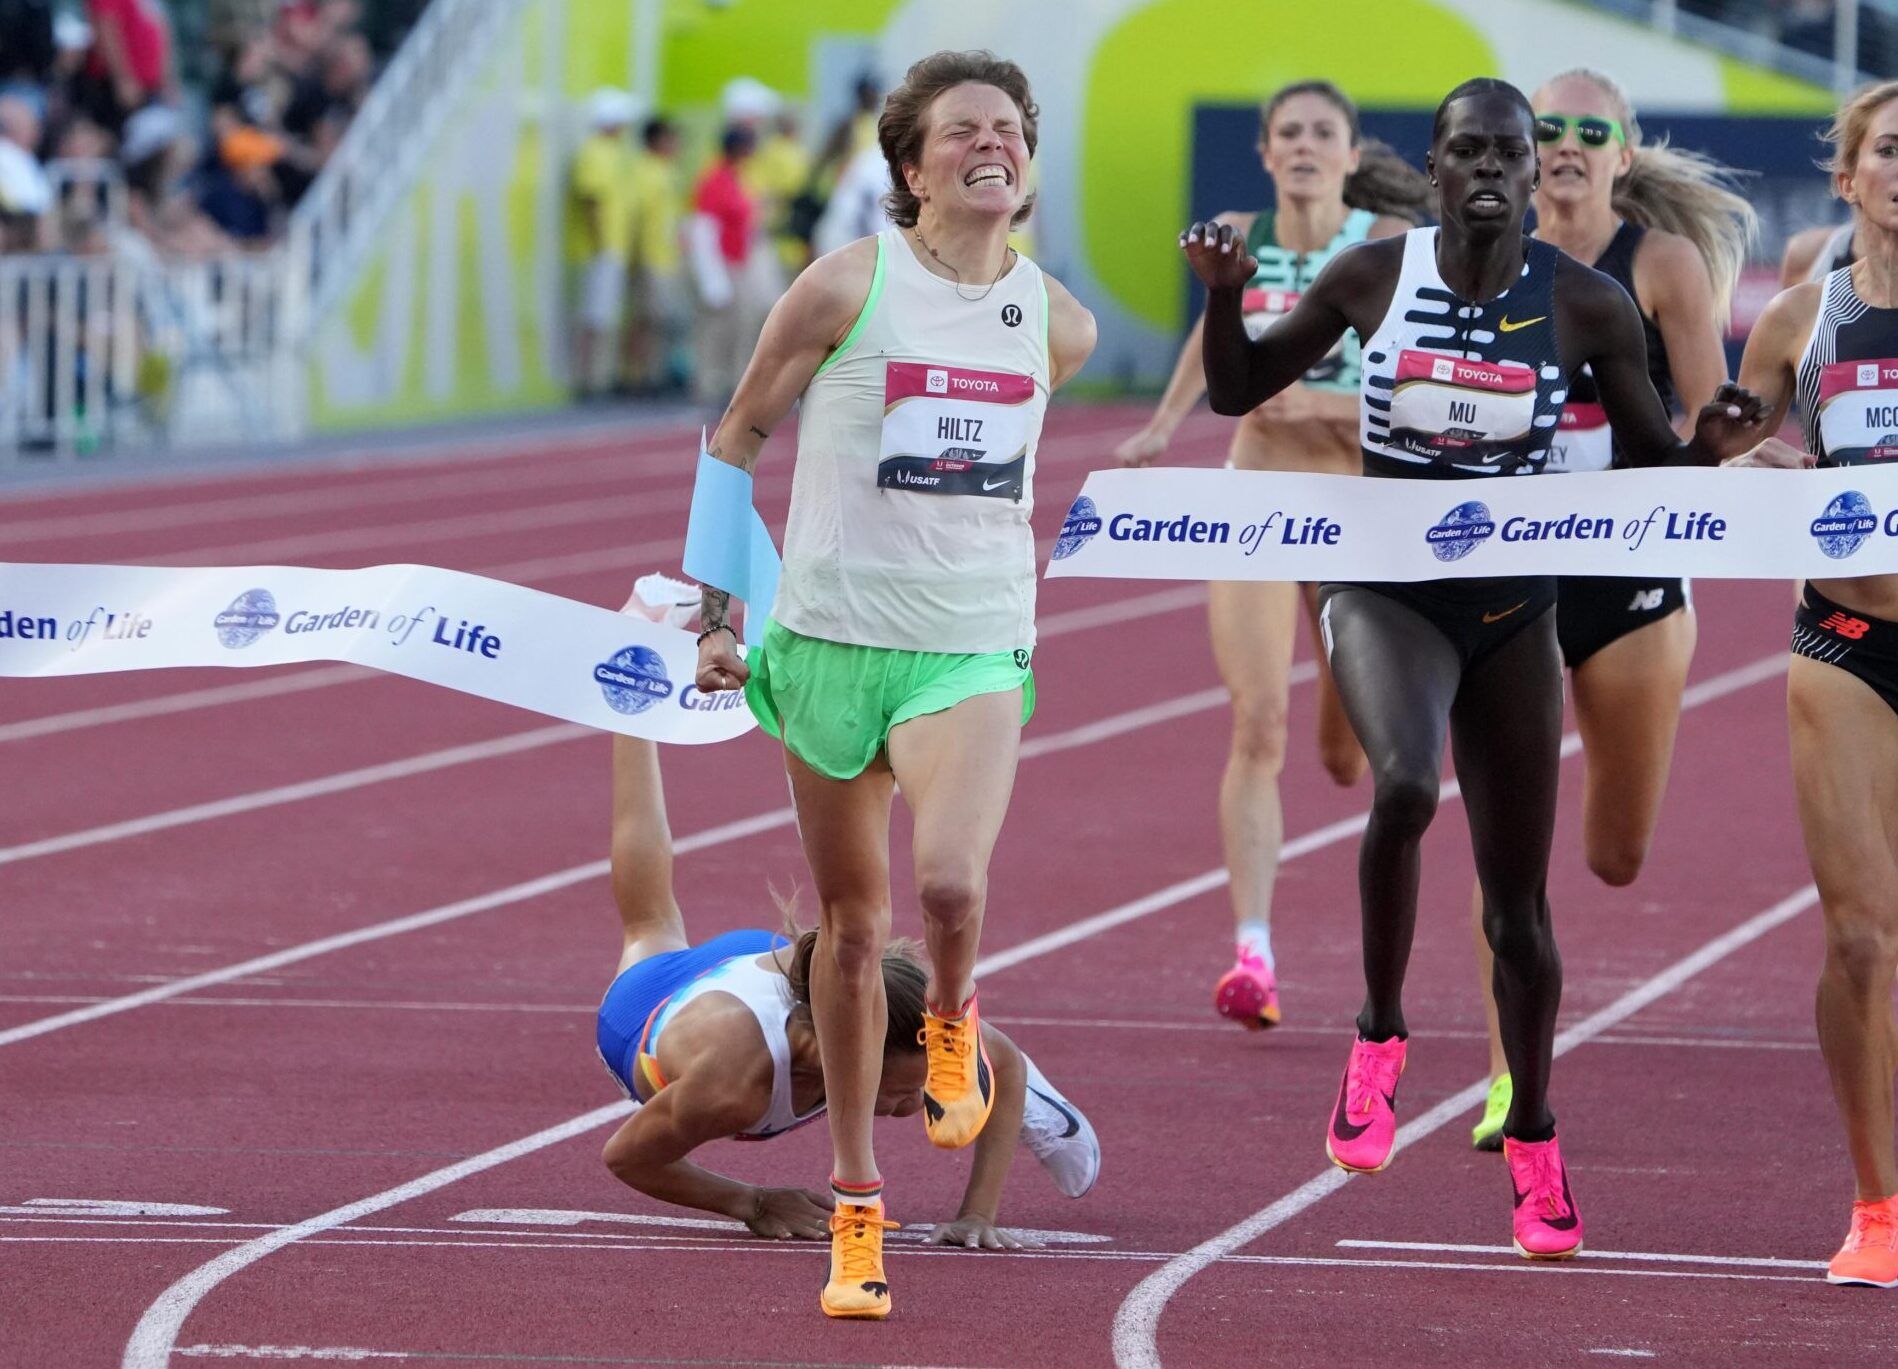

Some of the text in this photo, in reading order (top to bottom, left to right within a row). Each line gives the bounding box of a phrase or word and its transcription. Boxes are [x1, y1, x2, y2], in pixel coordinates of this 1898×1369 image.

[952, 378, 999, 392] TOYOTA
[1457, 368, 1503, 383] TOYOTA
[1448, 400, 1477, 424] MU
[937, 416, 984, 443] HILTZ
[910, 475, 941, 486] USATF
[1080, 521, 1098, 531] Life
[1108, 511, 1342, 556] Garden of Life
[1429, 529, 1462, 539] Garden
[1473, 525, 1491, 535] Life
[1501, 505, 1727, 551] Garden of Life
[1813, 522, 1846, 532] Garden
[1858, 519, 1874, 530] Life
[66, 606, 105, 652] of
[103, 612, 153, 640] Life
[285, 605, 502, 659] Garden of Life
